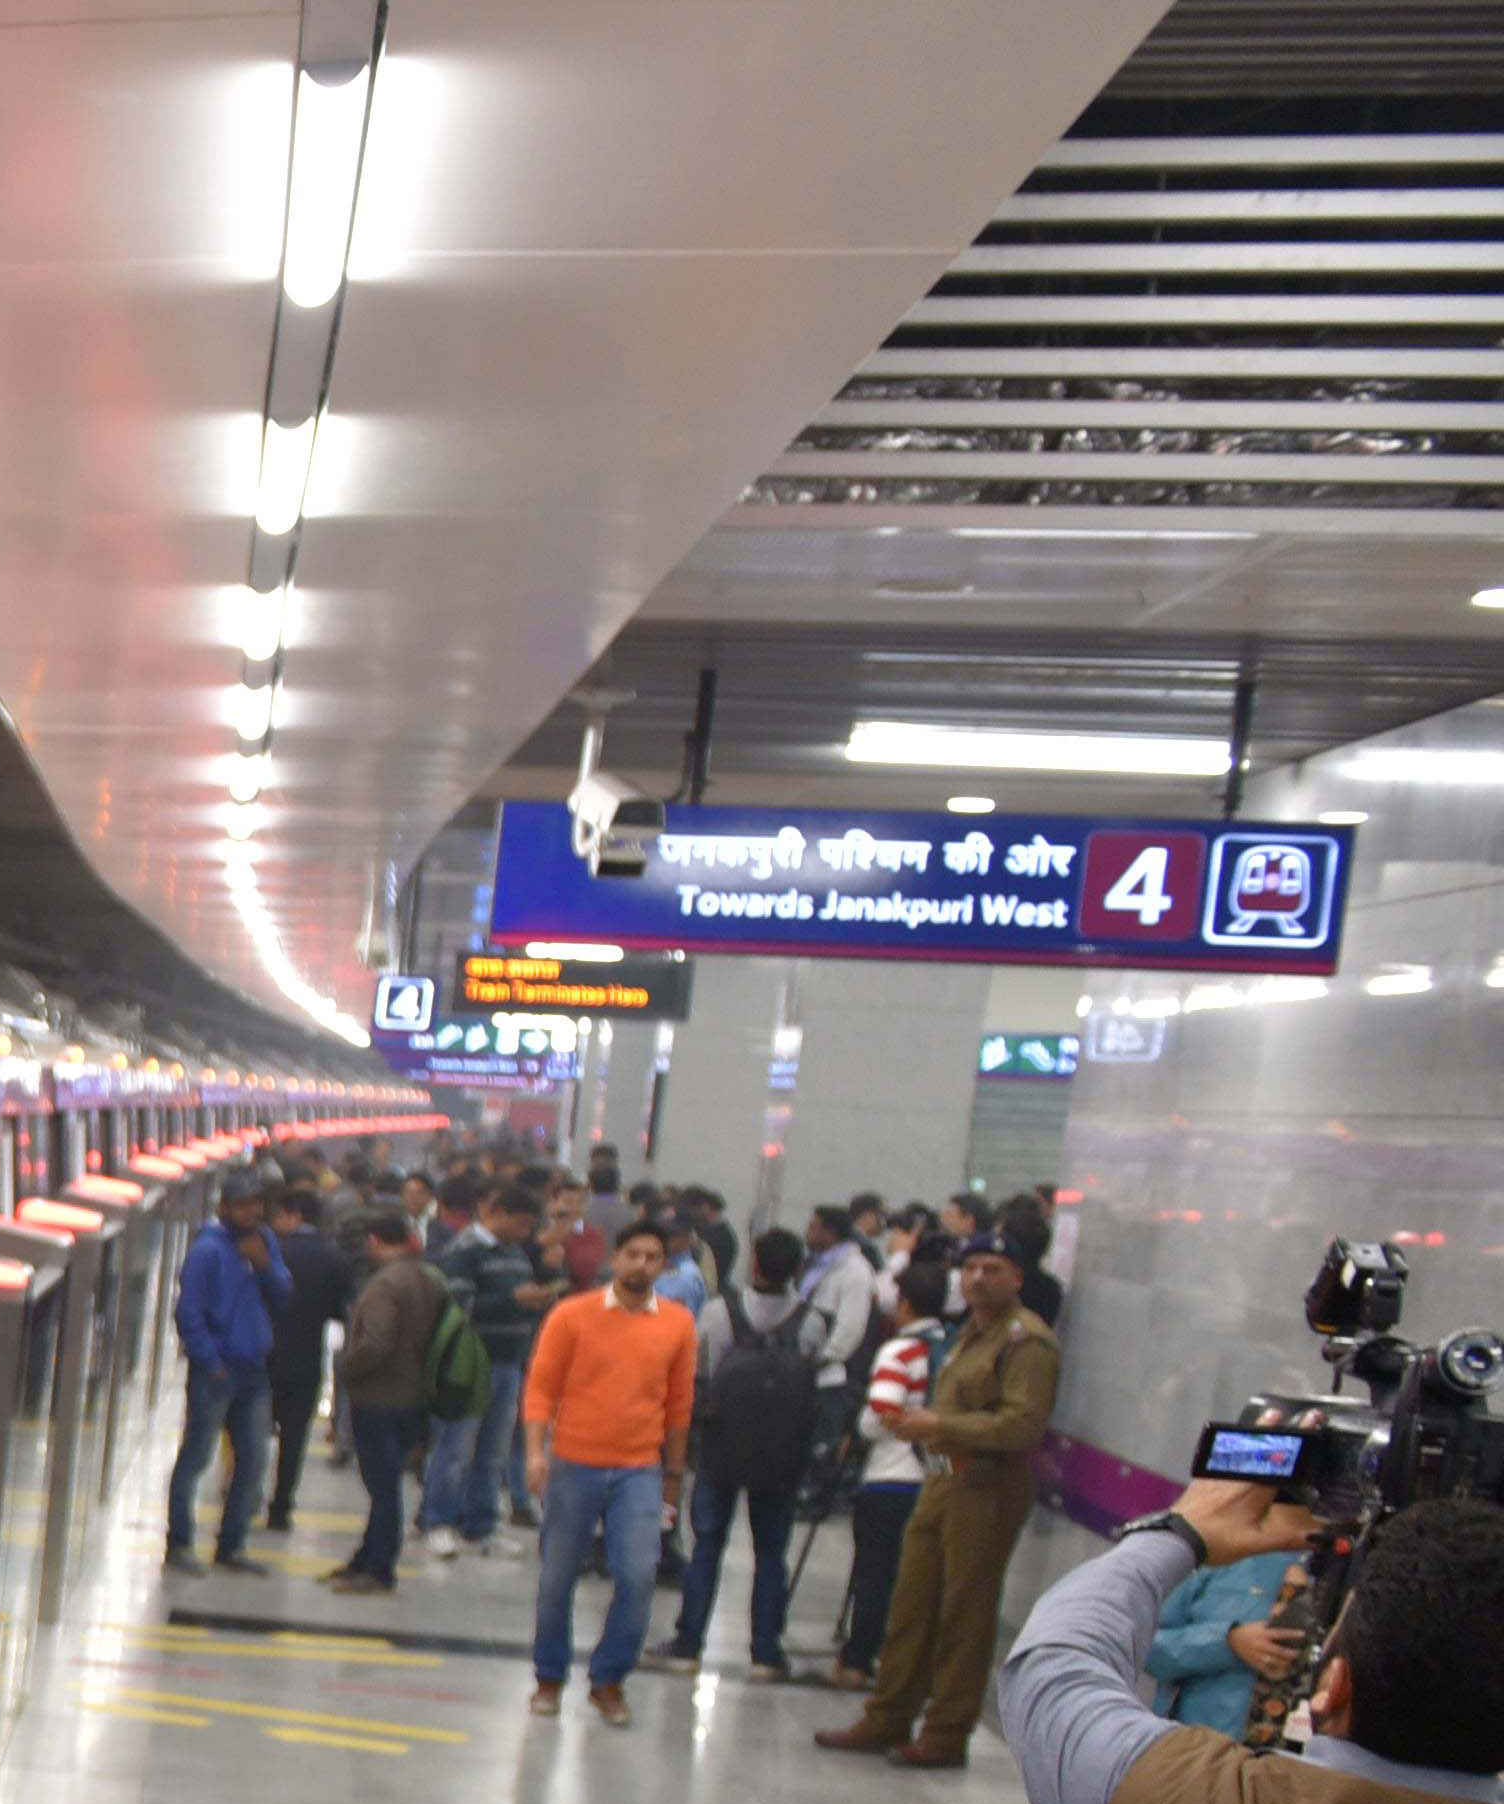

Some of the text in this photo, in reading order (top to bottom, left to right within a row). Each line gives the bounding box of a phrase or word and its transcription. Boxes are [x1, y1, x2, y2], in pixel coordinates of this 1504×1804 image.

[943, 831, 994, 874] की
[1004, 834, 1076, 876] ओर
[677, 883, 1068, 929] Towards Janakpuri West
[1103, 846, 1173, 926] 4
